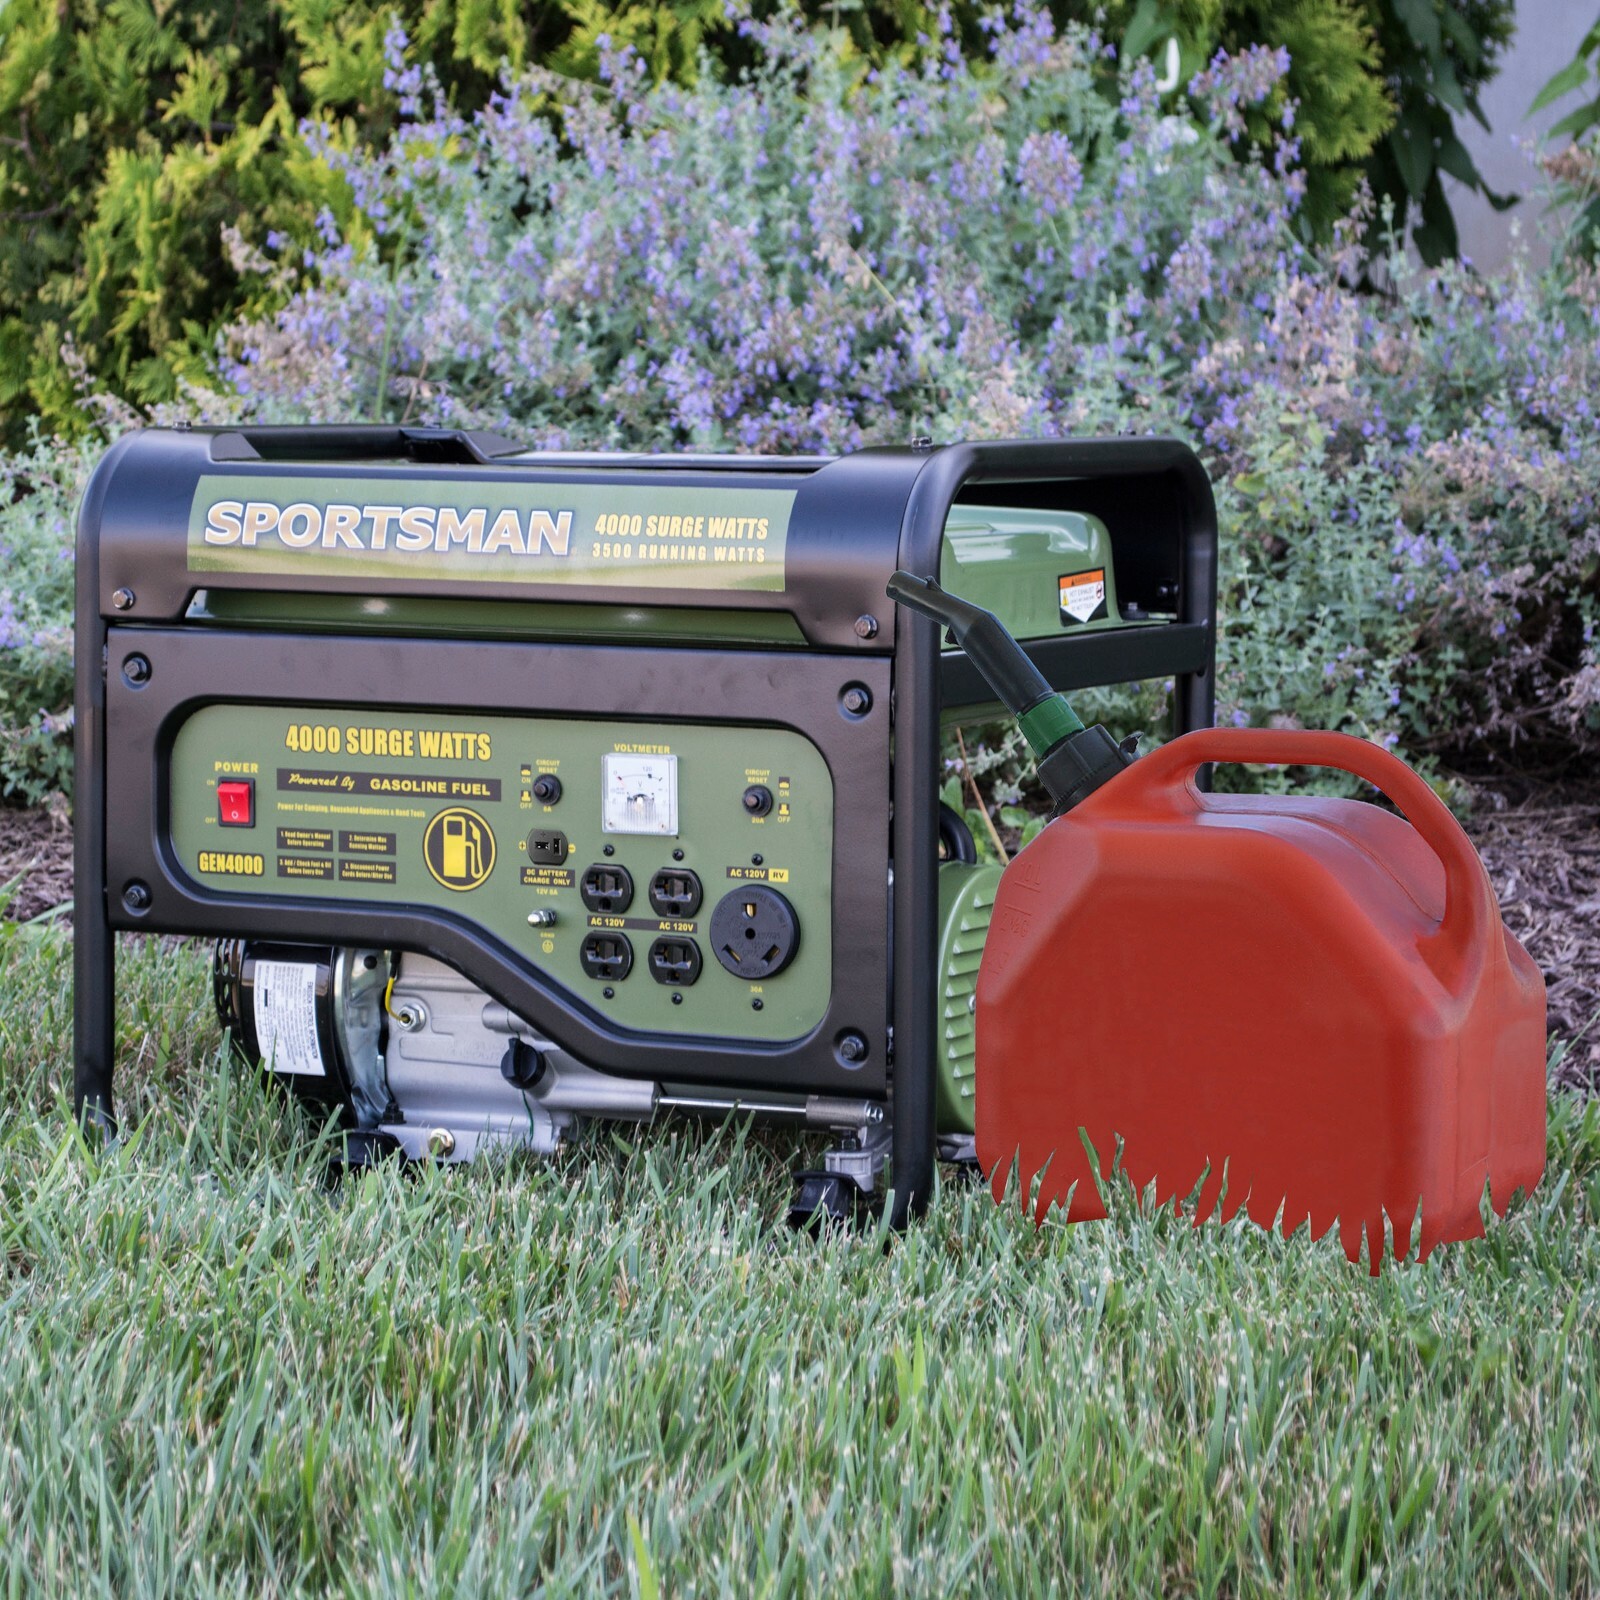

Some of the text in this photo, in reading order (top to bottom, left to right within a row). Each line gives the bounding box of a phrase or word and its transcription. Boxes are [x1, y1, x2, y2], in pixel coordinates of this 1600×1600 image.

[204, 501, 575, 556] SPORTSMAN
[594, 514, 768, 540] 4000 SURGE WATTS
[592, 542, 765, 563] 3500 RUNNING WATTS
[285, 724, 492, 761] 4000 SURGE WATTS
[614, 744, 670, 753] VOLTMETER
[215, 761, 258, 773] POWER
[341, 776, 355, 791] By
[370, 778, 490, 796] GASOLINE FUEL
[278, 802, 294, 811] Power
[199, 854, 263, 875] GEN4000
[539, 869, 567, 877] BATTERY
[730, 869, 784, 879] AC 120V RV
[553, 878, 570, 886] ONLY
[591, 918, 625, 928] AC 120V
[659, 922, 694, 932] AC 120V
